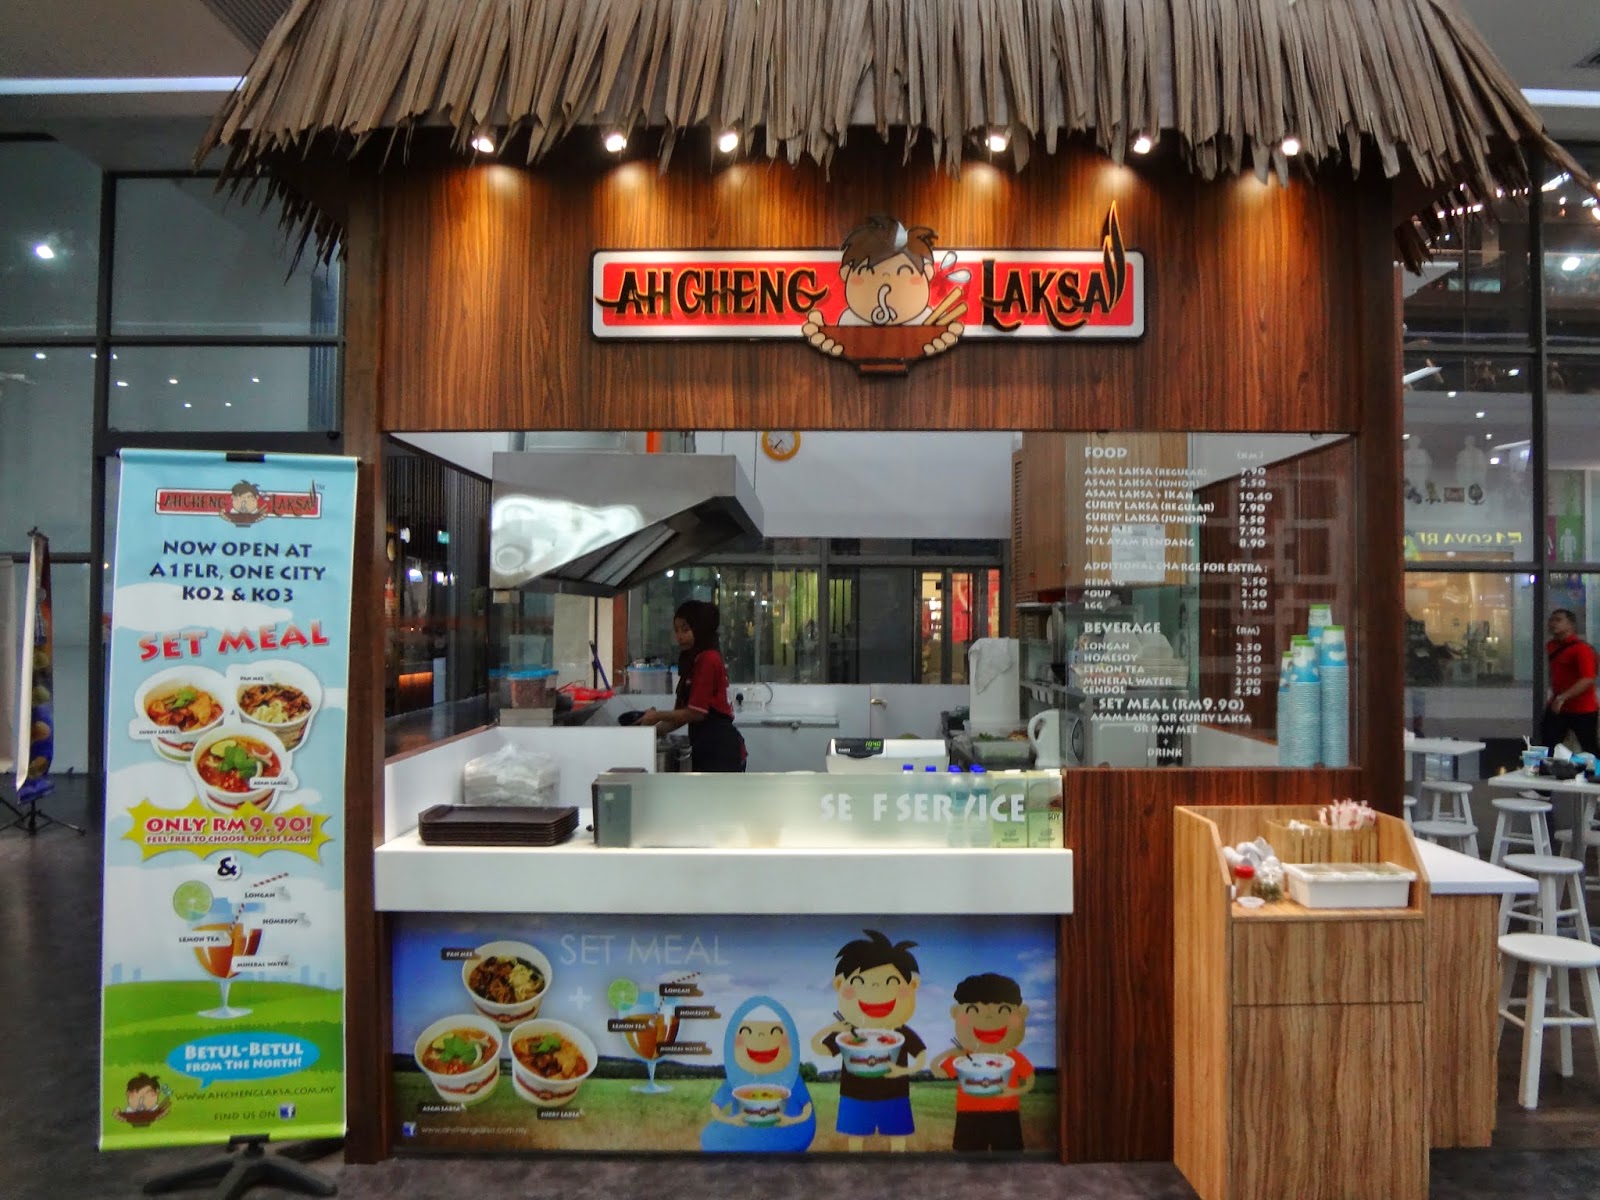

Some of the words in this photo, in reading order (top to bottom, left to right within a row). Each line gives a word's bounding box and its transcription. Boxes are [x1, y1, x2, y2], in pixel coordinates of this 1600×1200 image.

[981, 257, 1120, 331] LAKSA
[1084, 446, 1128, 459] FOOD
[1084, 466, 1116, 476] ASAM
[1119, 466, 1153, 476] LAKSA
[1240, 467, 1266, 477] 7.90
[1084, 478, 1116, 487] ASAM
[1119, 478, 1153, 487] LAKSA
[1155, 478, 1200, 488] (JUNIOR)
[1240, 478, 1266, 488] 5.50
[1085, 489, 1117, 498] ASAM
[1120, 489, 1154, 499] LAKSA
[1164, 490, 1194, 500] IKAN
[1239, 491, 1273, 502] 10.40
[1085, 500, 1122, 510] CURRY
[1124, 501, 1159, 511] LAKSA
[1161, 501, 1215, 512] (REGULAR)
[1239, 502, 1266, 513] 7.90
[1085, 512, 1122, 522] CURRY
[1124, 513, 1159, 523] LAKSA
[1161, 513, 1207, 524] (JUNIOR)
[1239, 514, 1266, 525] 5.50
[1085, 524, 1109, 534] PAN
[1239, 526, 1266, 537] 7.90
[1085, 537, 1105, 546] N/L
[1142, 538, 1195, 547] RENDANG
[1239, 538, 1266, 548] 8.90
[163, 540, 217, 556] NOW
[221, 541, 279, 557] OPEN
[284, 544, 313, 558] AT
[230, 564, 275, 579] ONE
[279, 566, 326, 581] CITY
[1203, 562, 1225, 573] FOR
[1241, 576, 1268, 587] 2.50
[231, 587, 246, 602] &
[1241, 588, 1268, 599] 2.50
[1241, 600, 1268, 610] 1.20
[1084, 621, 1161, 634] BEVERAGE
[1236, 625, 1261, 637] (RM)
[137, 629, 208, 662] SET
[217, 619, 330, 654] MEAL
[1084, 642, 1130, 651] LONGAN
[1236, 642, 1262, 653] 2.50
[1084, 653, 1138, 662] HOMESOY
[1236, 654, 1262, 665] 2.50
[1083, 664, 1122, 673] LEMON
[1125, 664, 1145, 674] TEA
[1236, 666, 1262, 676] 2.50
[1083, 676, 1134, 686] MINERAL
[1135, 677, 1173, 686] WATER
[1236, 677, 1262, 687] 2.00
[1082, 685, 1126, 695] CENDOL
[1234, 686, 1262, 697] 4.50
[1099, 698, 1125, 710] SET
[1127, 698, 1170, 711] MEAL
[1172, 697, 1245, 712] (RM9.90)
[1090, 713, 1123, 722] ASAM
[1125, 713, 1160, 722] LAKSA
[1161, 714, 1177, 723] OR
[1179, 714, 1216, 723] CURRY
[1217, 714, 1252, 724] LAKSA
[1133, 725, 1149, 733] OR
[1151, 725, 1174, 734] PAN
[1175, 725, 1198, 734] MEE
[1147, 748, 1182, 757] DRINK
[820, 793, 888, 822] SEF
[146, 816, 207, 834] ONLY
[146, 835, 169, 843] FEEL
[170, 835, 192, 843] FREE
[193, 835, 207, 843] TO
[208, 835, 245, 843] CHOOSE
[247, 835, 267, 843] ONE
[269, 835, 282, 843] OF
[283, 835, 311, 843] EACH!
[217, 856, 238, 877] &
[244, 891, 276, 899] LONGAN
[560, 933, 616, 966] SET
[628, 933, 731, 966] MEAL
[185, 1061, 222, 1072] FROM
[225, 1059, 250, 1071] THE
[252, 1057, 303, 1070] NORTH!
[213, 1111, 240, 1121] FIND
[242, 1111, 256, 1120] US
[258, 1111, 276, 1119] ON
